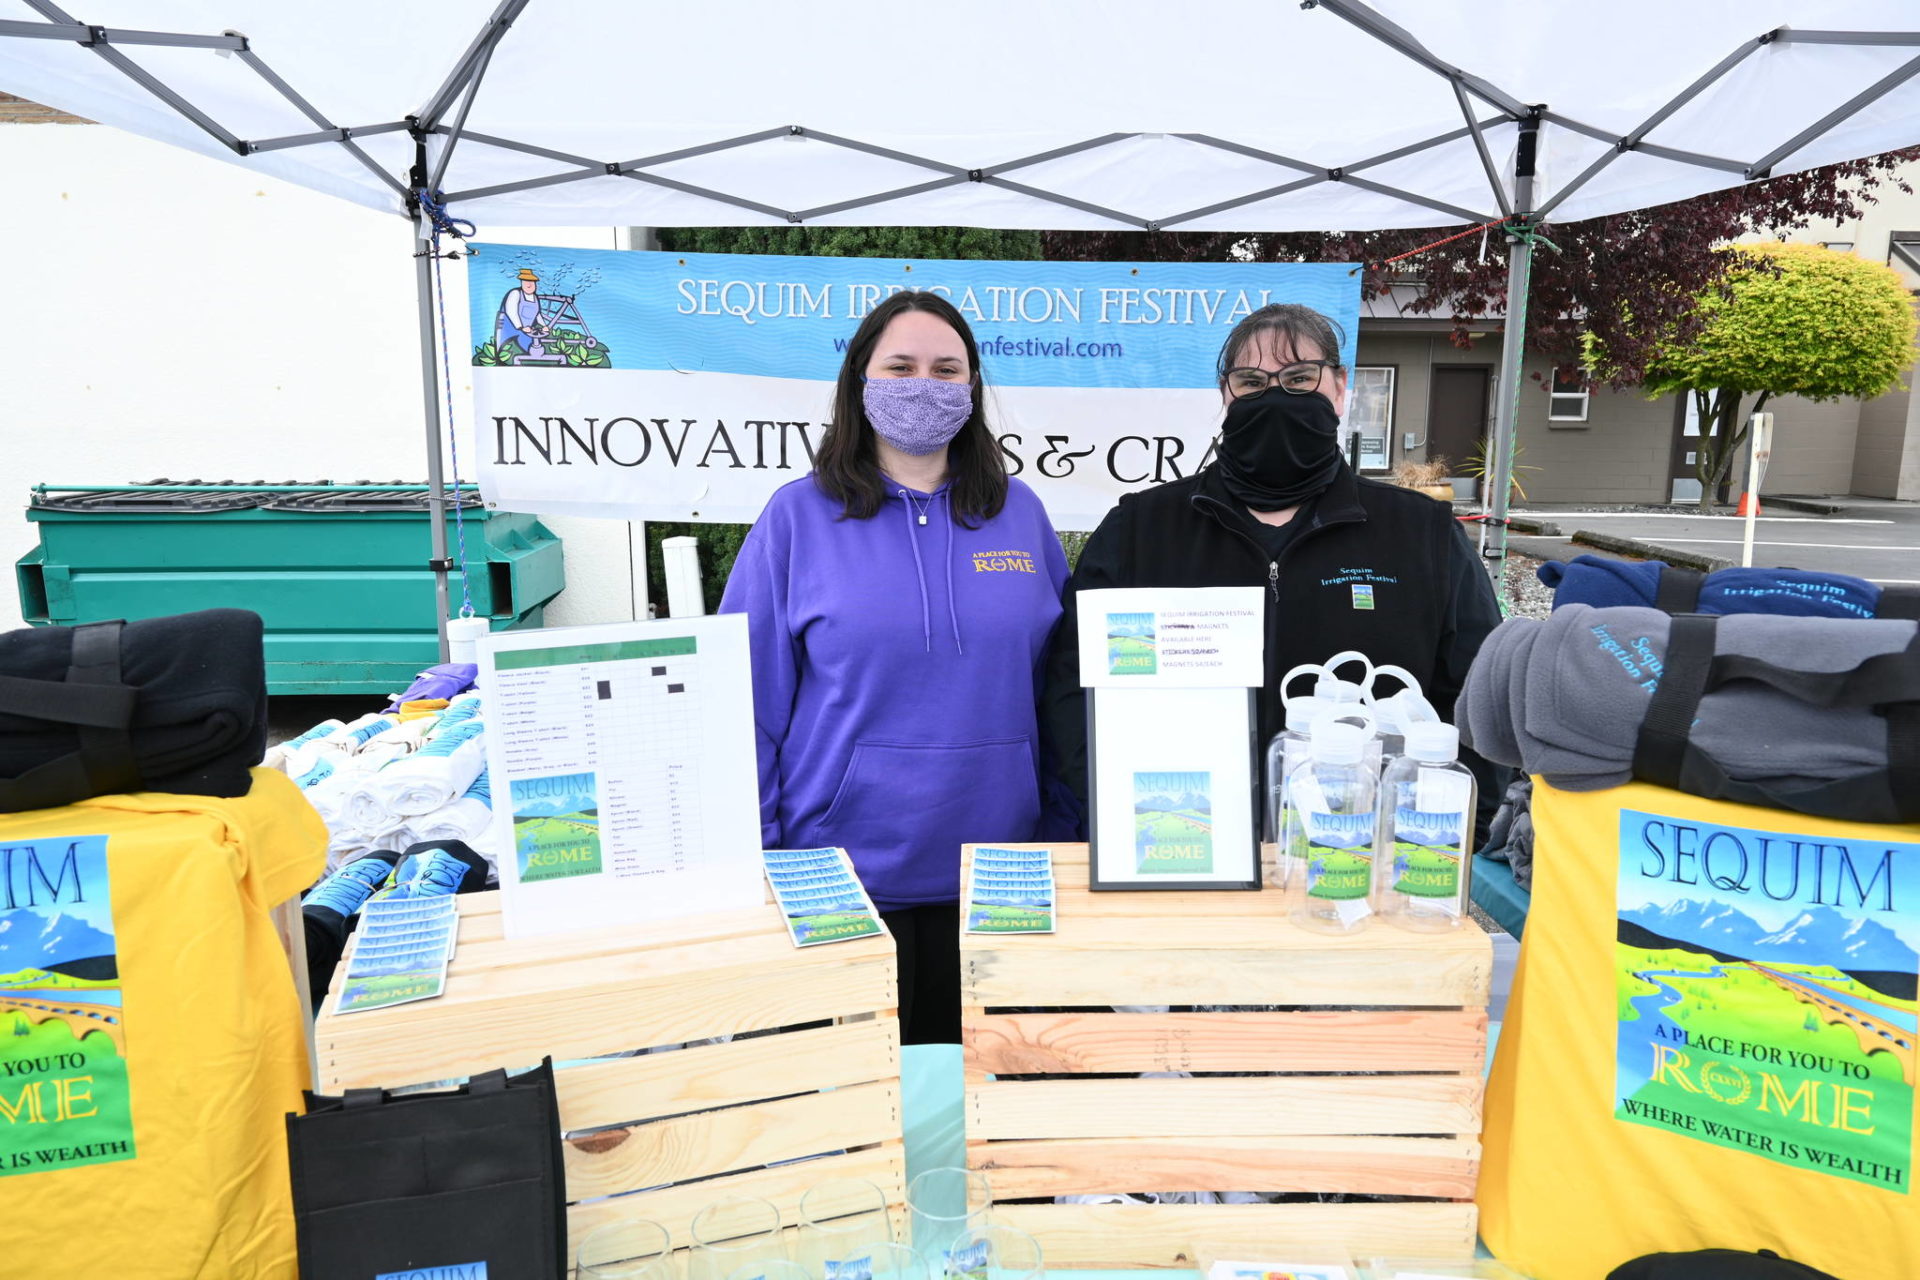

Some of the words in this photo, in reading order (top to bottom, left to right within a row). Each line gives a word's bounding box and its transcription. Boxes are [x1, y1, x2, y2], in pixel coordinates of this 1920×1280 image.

[676, 278, 832, 325] SEQUIM
[847, 284, 1084, 324] IRATION
[1036, 435, 1096, 478] &
[972, 558, 1037, 573] ROME
[1321, 574, 1363, 586] Irrigation
[1365, 574, 1397, 584] Festival
[1340, 567, 1373, 576] Sequim
[516, 773, 590, 801] SEQUIM
[527, 846, 593, 868] ROME
[1640, 820, 1900, 913] SEQUIM
[3, 1056, 50, 1077] YOU
[54, 1051, 86, 1070] TO
[1655, 1023, 1668, 1039] A
[1671, 1026, 1735, 1056] PLACE
[1740, 1041, 1783, 1065] FOR
[1788, 1050, 1835, 1075] YOU
[1839, 1061, 1872, 1081] TO
[1649, 1040, 1877, 1136] ROME
[10, 1151, 32, 1169] IS
[35, 1140, 128, 1164] WEALTH
[1622, 1097, 1698, 1133] WHERE
[1702, 1118, 1773, 1154] WATER
[1780, 1140, 1799, 1160] IS
[1804, 1146, 1903, 1186] WEALTH
